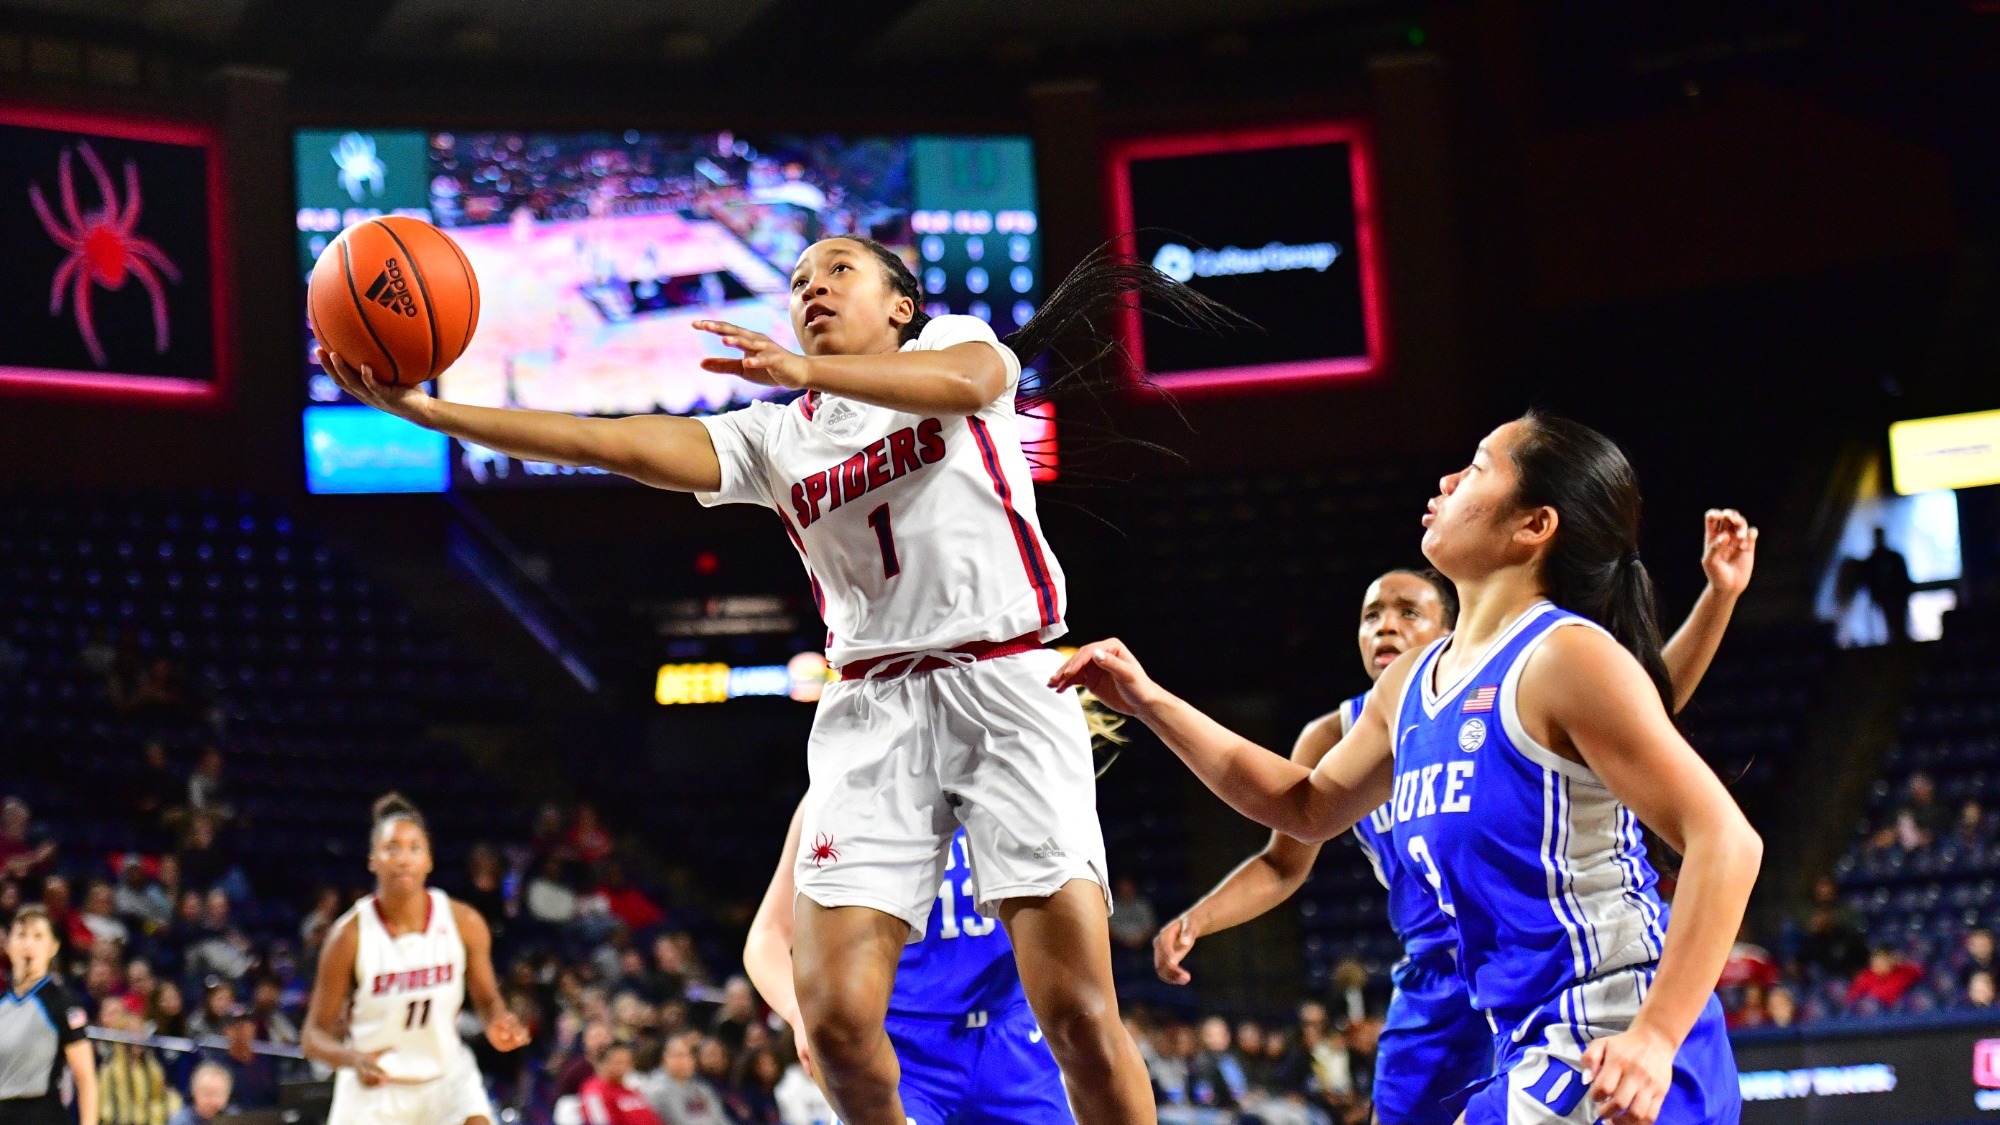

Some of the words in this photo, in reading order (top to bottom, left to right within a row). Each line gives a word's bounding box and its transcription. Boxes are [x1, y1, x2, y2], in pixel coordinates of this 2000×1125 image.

[385, 257, 418, 317] adidas
[828, 411, 858, 426] adidas
[791, 418, 946, 529] SPIDERS
[868, 502, 900, 580] 1
[1033, 850, 1066, 859] adidas
[406, 999, 431, 1029] 11
[1522, 1054, 1593, 1118] D
